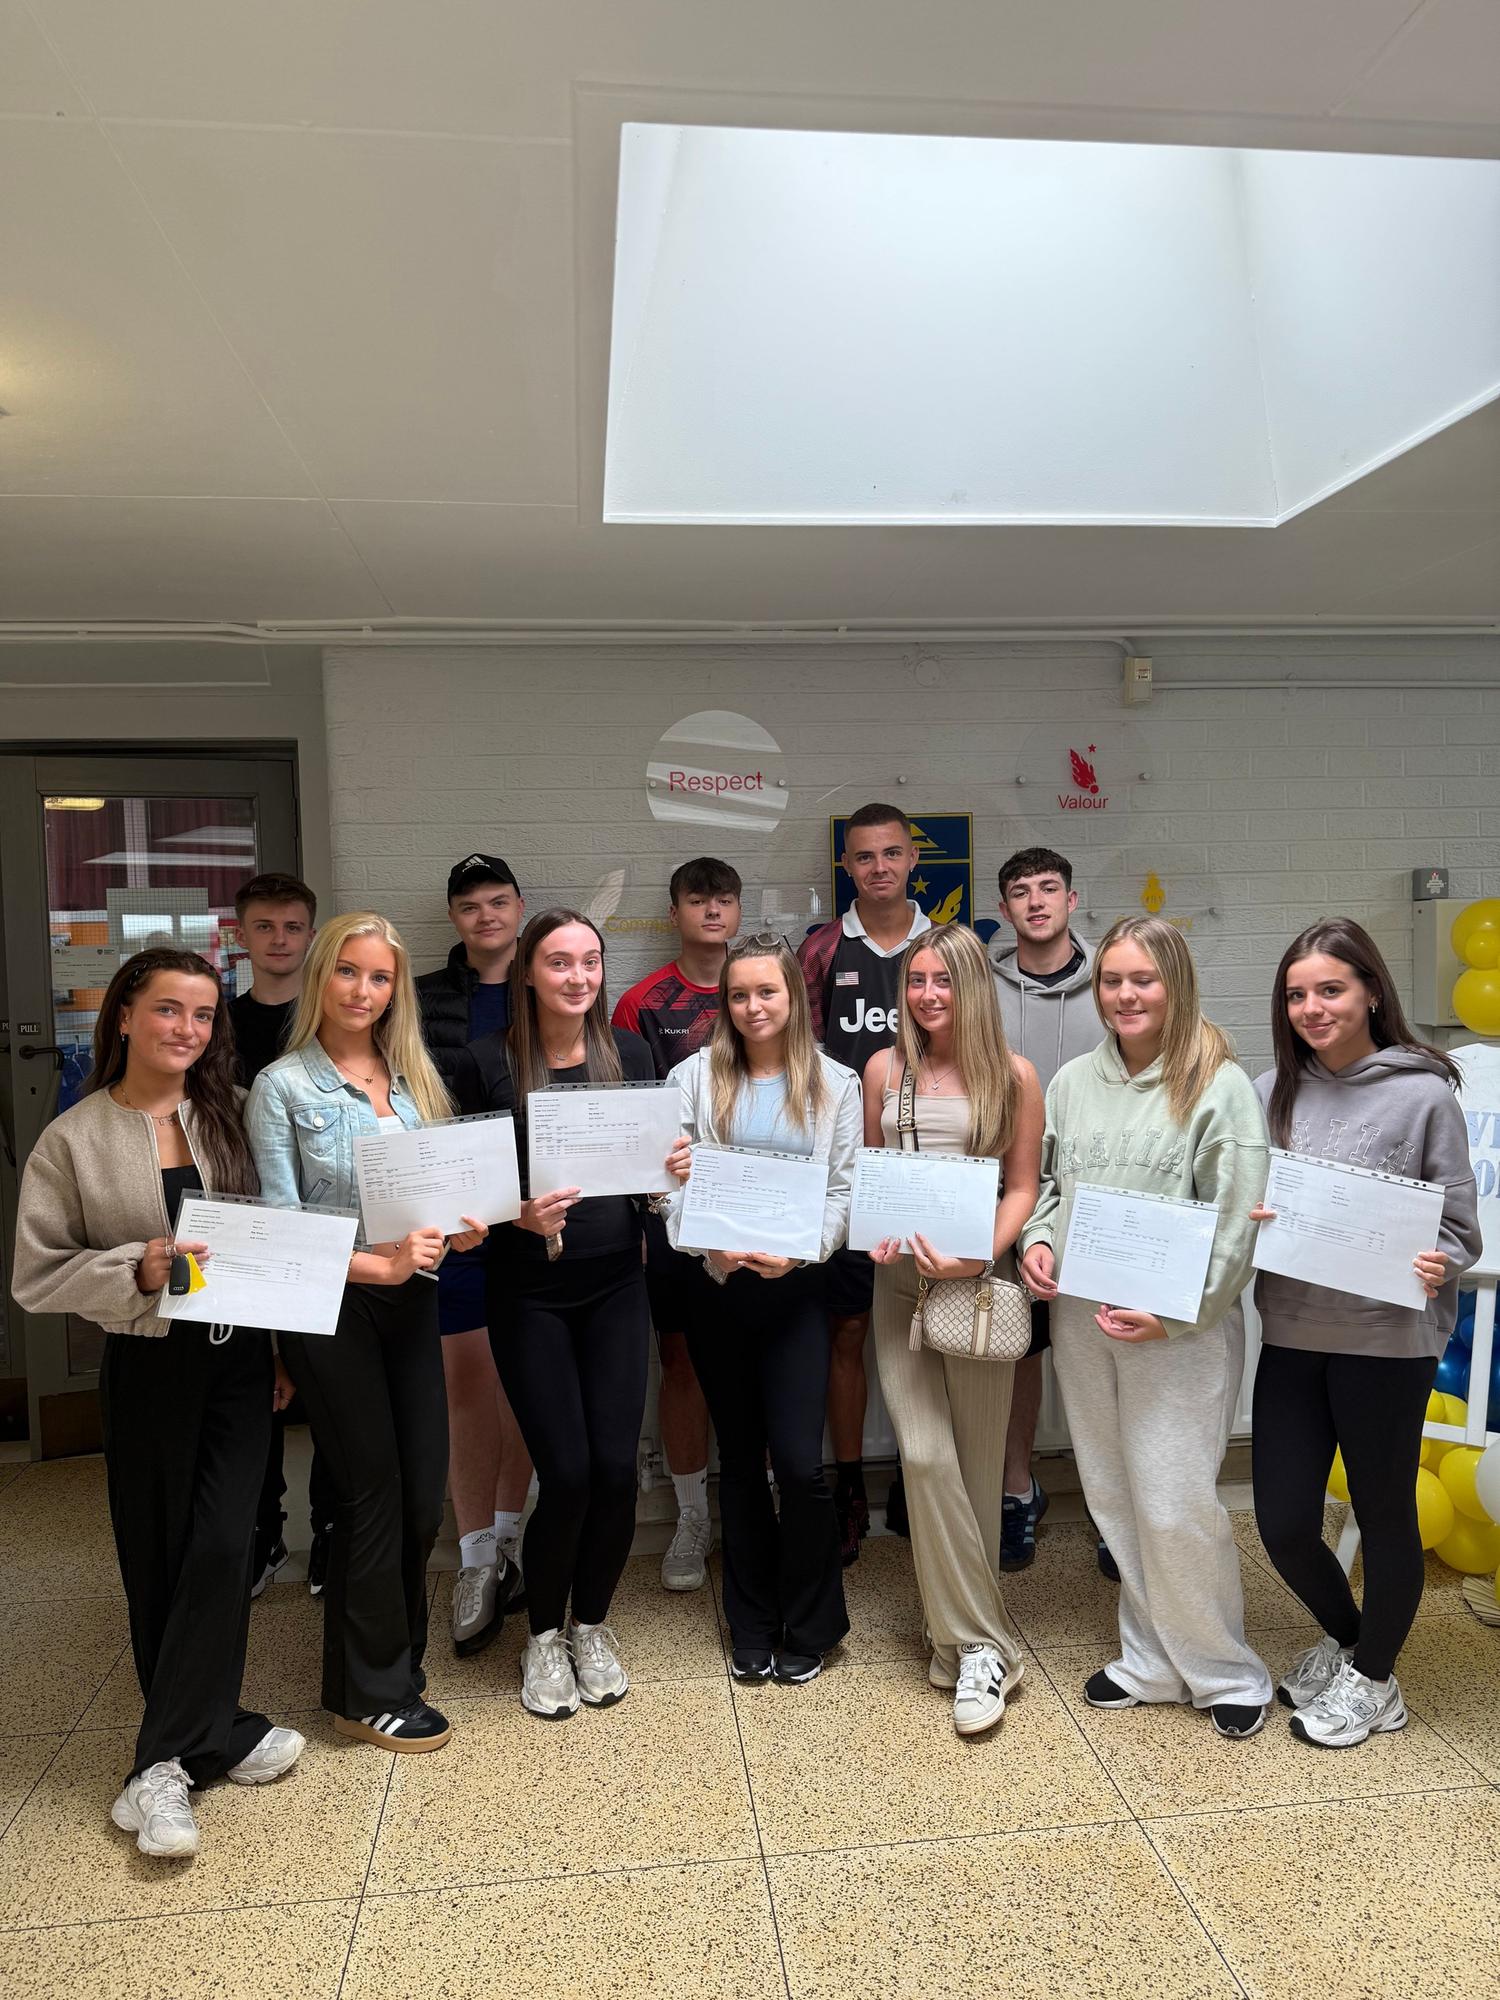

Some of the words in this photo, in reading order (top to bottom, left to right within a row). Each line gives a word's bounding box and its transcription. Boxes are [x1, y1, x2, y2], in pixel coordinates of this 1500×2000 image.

[669, 771, 763, 795] Respect
[1057, 795, 1109, 809] Valour
[20, 1024, 39, 1033] PULL
[901, 1092, 912, 1128] RVER
